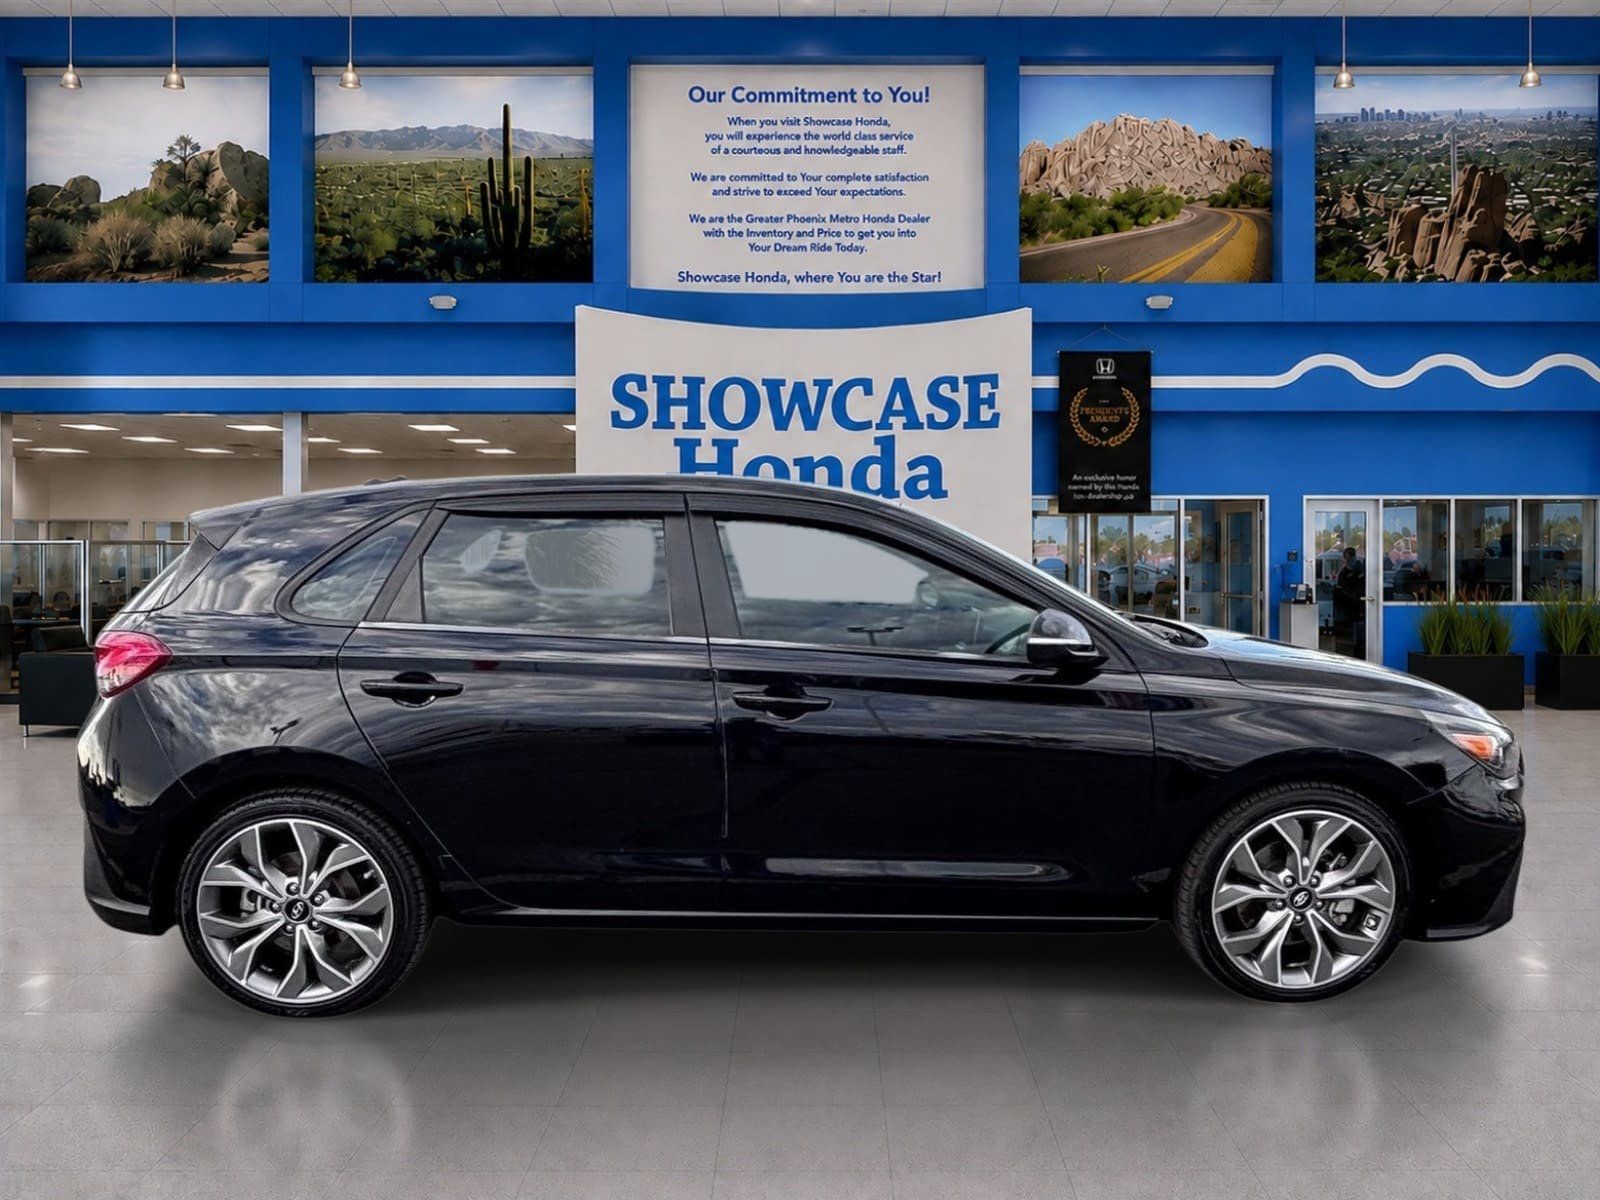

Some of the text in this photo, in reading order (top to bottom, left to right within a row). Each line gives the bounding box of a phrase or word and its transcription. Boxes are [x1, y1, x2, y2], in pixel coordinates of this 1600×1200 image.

[688, 85, 930, 103] Our Commitment to You!
[727, 117, 891, 128] When you visit Showcase Honda,
[705, 131, 914, 143] you will experience the world class service
[711, 145, 721, 154] of
[731, 147, 781, 155] courteous
[783, 145, 802, 154] and
[882, 144, 906, 155] staff.
[691, 172, 707, 182] We
[729, 172, 784, 182] committed
[787, 174, 797, 182] to
[800, 173, 822, 182] Your
[825, 172, 872, 184] complete
[874, 172, 929, 182] satisfaction
[712, 186, 906, 199] and strive to exceed Your expectations.
[689, 214, 706, 224] We
[727, 214, 743, 223] the
[745, 214, 784, 223] Greater
[786, 214, 826, 223] Phoenix
[830, 214, 860, 223] Metro
[863, 214, 895, 223] Honda
[898, 213, 931, 223] Dealer
[703, 228, 916, 240] with the Inventory and Price to get you into
[748, 242, 867, 254] Your Dream Ride Today.
[678, 271, 941, 285] Showcase Honda, where You are the Star!
[610, 372, 1001, 432] SHOWCASE
[1094, 483, 1103, 491] by
